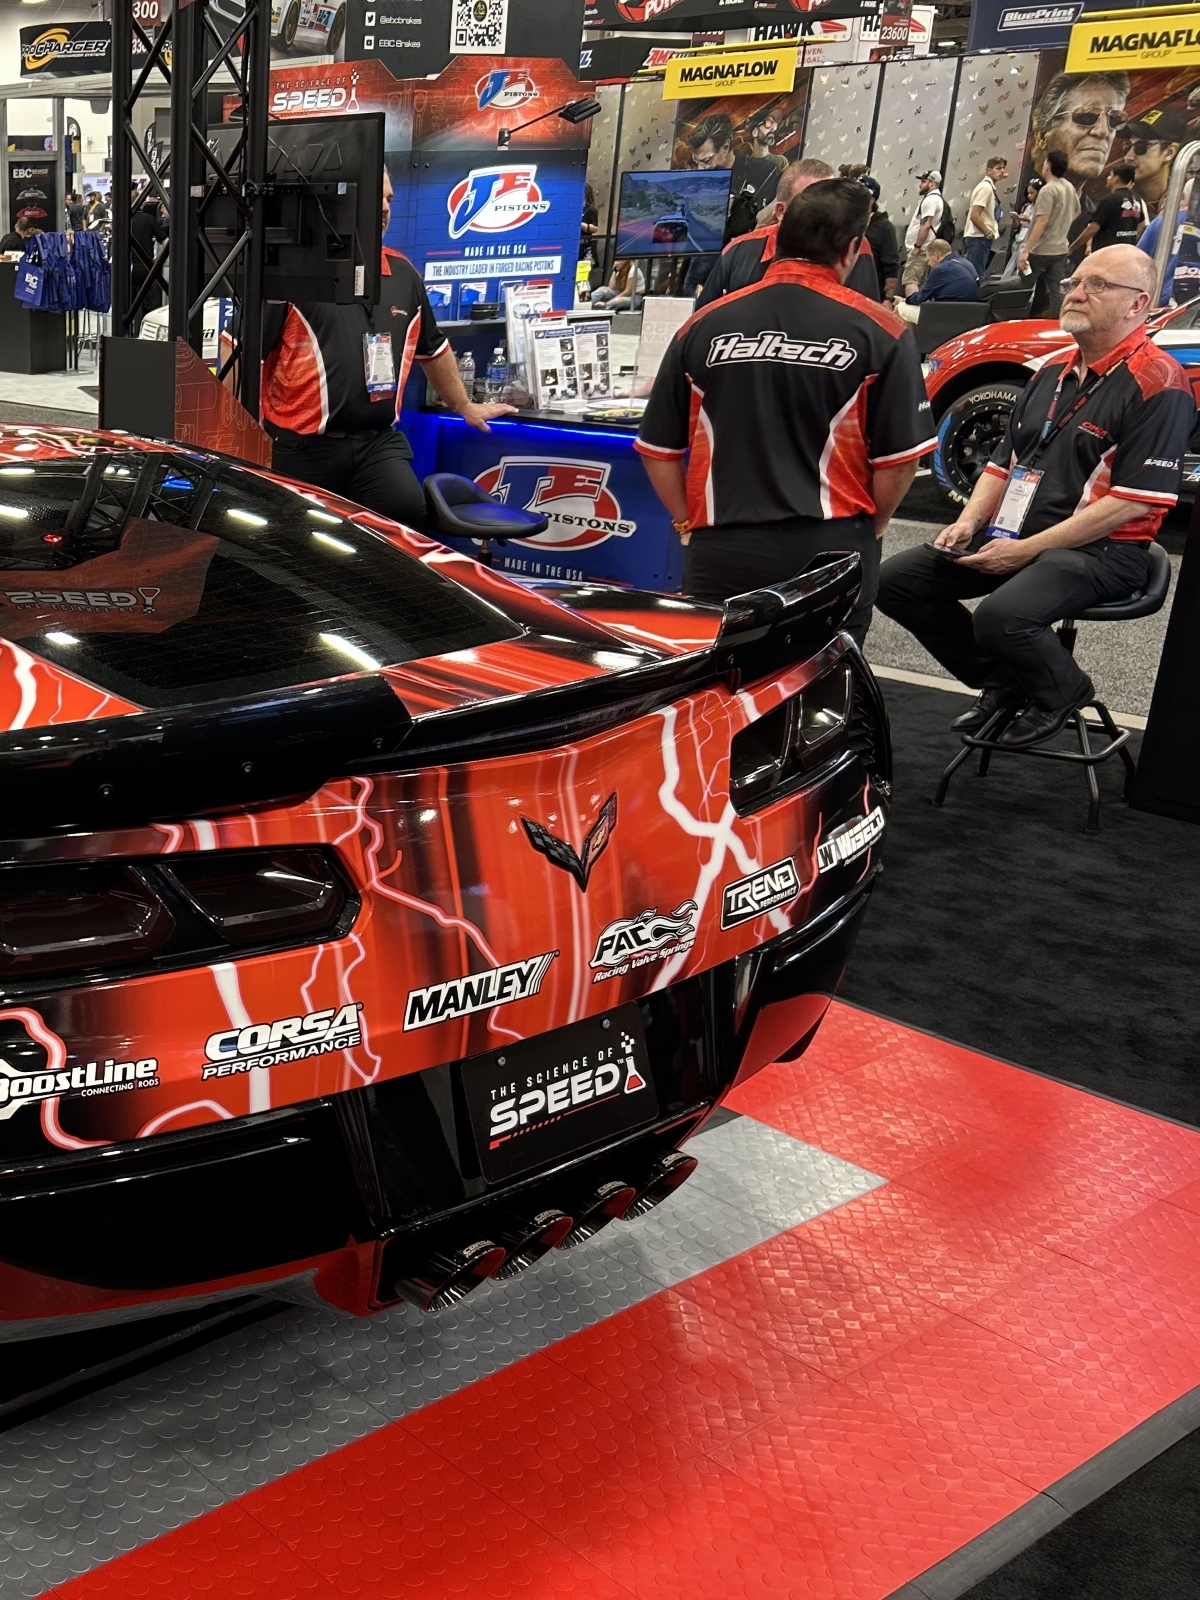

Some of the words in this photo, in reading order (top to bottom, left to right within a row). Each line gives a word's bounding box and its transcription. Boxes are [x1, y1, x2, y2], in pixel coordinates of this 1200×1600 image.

[1004, 8, 1076, 22] BluePrint
[881, 27, 909, 40] 23600
[1140, 50, 1171, 59] GROUP
[680, 59, 778, 83] MAGNAFLOW
[276, 81, 290, 89] THE
[295, 78, 331, 88] SCIENCE
[271, 88, 347, 111] SPEED
[13, 169, 32, 178] EBC
[494, 203, 548, 212] PISTONS
[464, 246, 484, 257] MADE
[486, 246, 494, 256] IN
[498, 245, 511, 255] THE
[513, 244, 527, 255] USA
[432, 266, 443, 277] THE
[443, 264, 469, 276] INDUSTRY
[469, 263, 488, 274] LEADER
[489, 263, 495, 273] IN
[495, 261, 514, 273] FORGED
[515, 260, 533, 272] RACING
[533, 260, 555, 271] PISTONS
[708, 334, 855, 368] Haltech
[968, 391, 1018, 404] YOKOHAMA
[1144, 459, 1173, 468] SPEED
[540, 511, 630, 534] PISTONS
[504, 557, 527, 571] MADE
[531, 562, 541, 574] IN
[546, 564, 561, 578] THE
[566, 567, 583, 582] USA
[726, 864, 795, 911] TREND
[760, 886, 797, 908] PERFORMANCE
[596, 925, 652, 962] PAC
[593, 963, 629, 983] Racing
[631, 953, 658, 969] Valve
[659, 939, 696, 959] Springs
[408, 961, 538, 1025] MANLEY
[205, 1004, 361, 1061] CORSA
[202, 1033, 361, 1081] PERFORMANCE
[491, 1082, 516, 1100] THE
[526, 1056, 588, 1087] SCIENCE
[598, 1047, 613, 1061] OF
[81, 1082, 134, 1097] CONNECTING
[138, 1077, 160, 1089] RODS
[490, 1062, 620, 1136] SPEED
